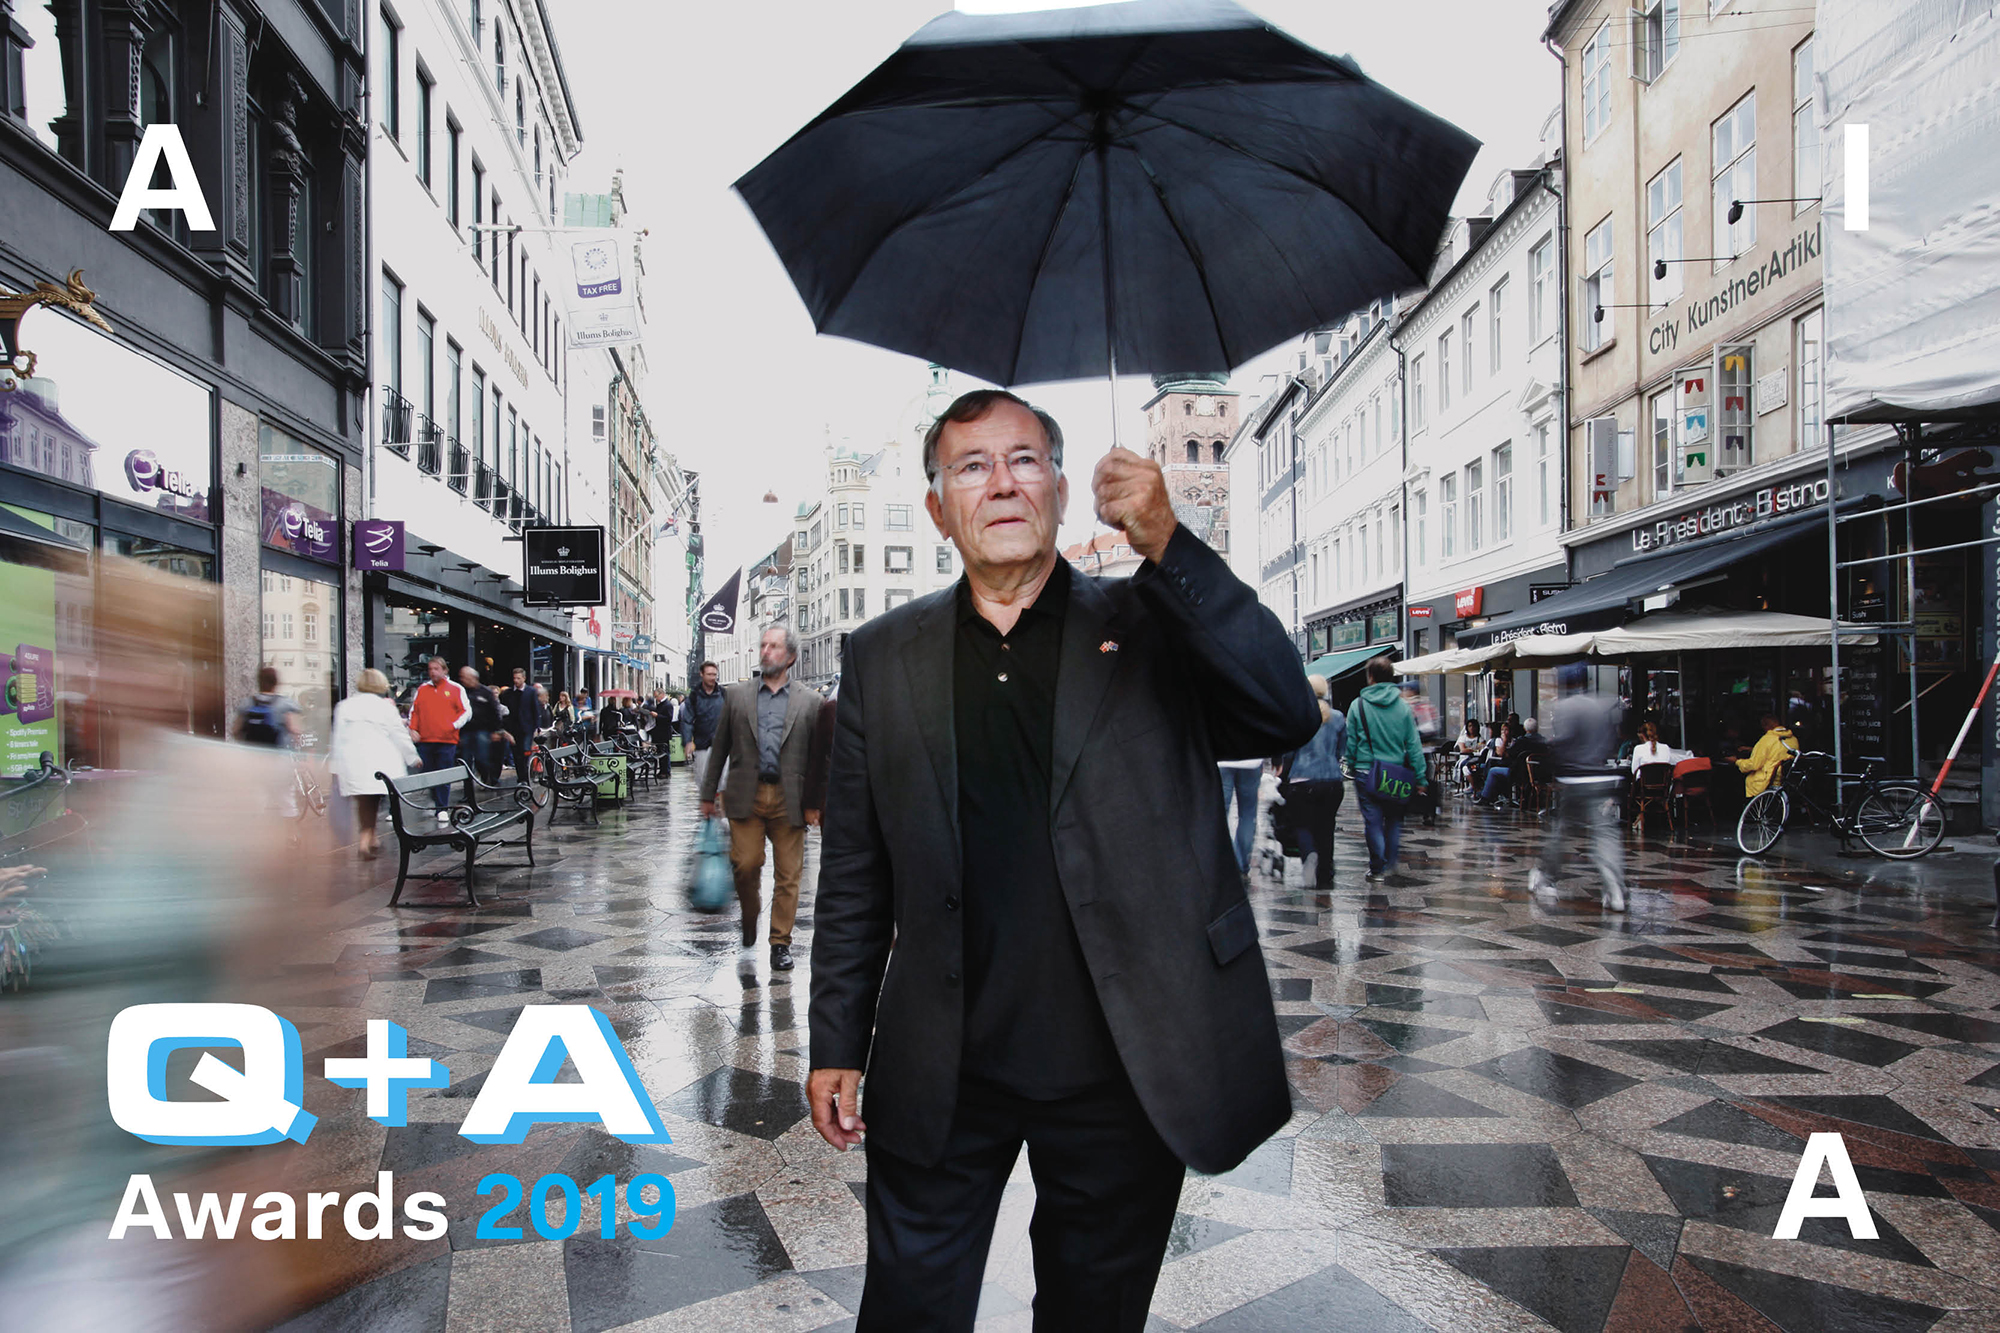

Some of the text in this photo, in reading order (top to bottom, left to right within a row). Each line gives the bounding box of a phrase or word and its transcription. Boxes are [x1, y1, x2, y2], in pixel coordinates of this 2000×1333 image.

[582, 283, 618, 296] TAX FREE
[1649, 222, 1821, 354] City KunstnerArtikl
[576, 328, 633, 340] Illums Bolighus
[163, 469, 194, 498] Telia
[1633, 479, 1830, 551] Le Président Bistro
[302, 517, 324, 543] Telia
[371, 559, 389, 567] Telia
[530, 565, 598, 577] Illums Bolighus
[1491, 633, 1500, 646] Le
